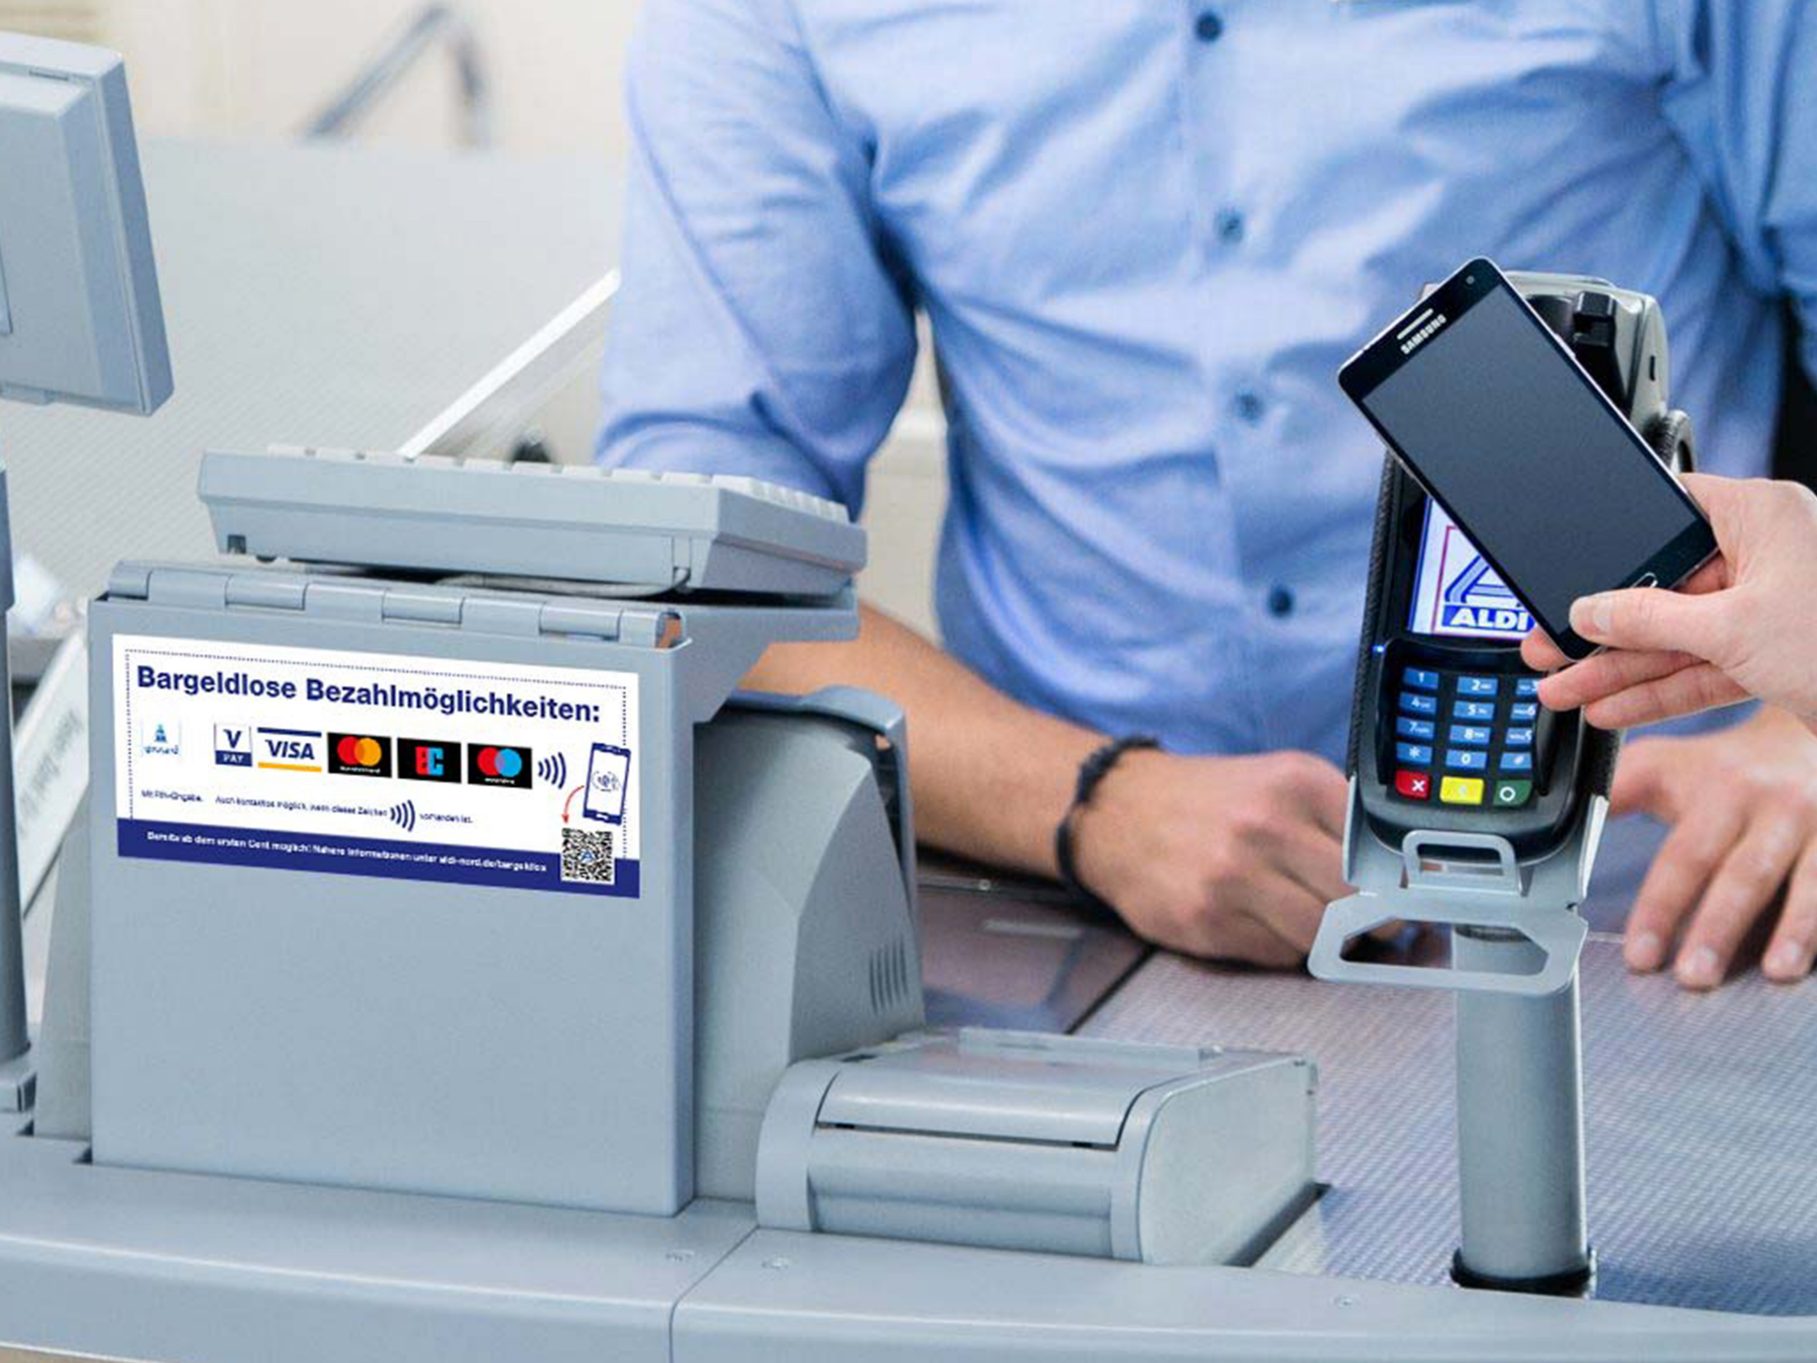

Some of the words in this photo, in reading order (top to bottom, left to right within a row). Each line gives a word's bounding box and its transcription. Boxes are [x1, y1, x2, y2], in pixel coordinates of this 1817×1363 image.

[1400, 313, 1446, 355] SAMSUNG
[1450, 607, 1529, 631] ALDI
[137, 665, 297, 698] Bargeldlose
[306, 678, 600, 723] Bezahlmöglichkeiten:
[1471, 679, 1481, 691] 2
[1411, 696, 1420, 707] 4
[222, 728, 242, 749] V
[222, 753, 244, 764] PAY
[264, 739, 315, 760] VISA
[415, 745, 444, 777] EC
